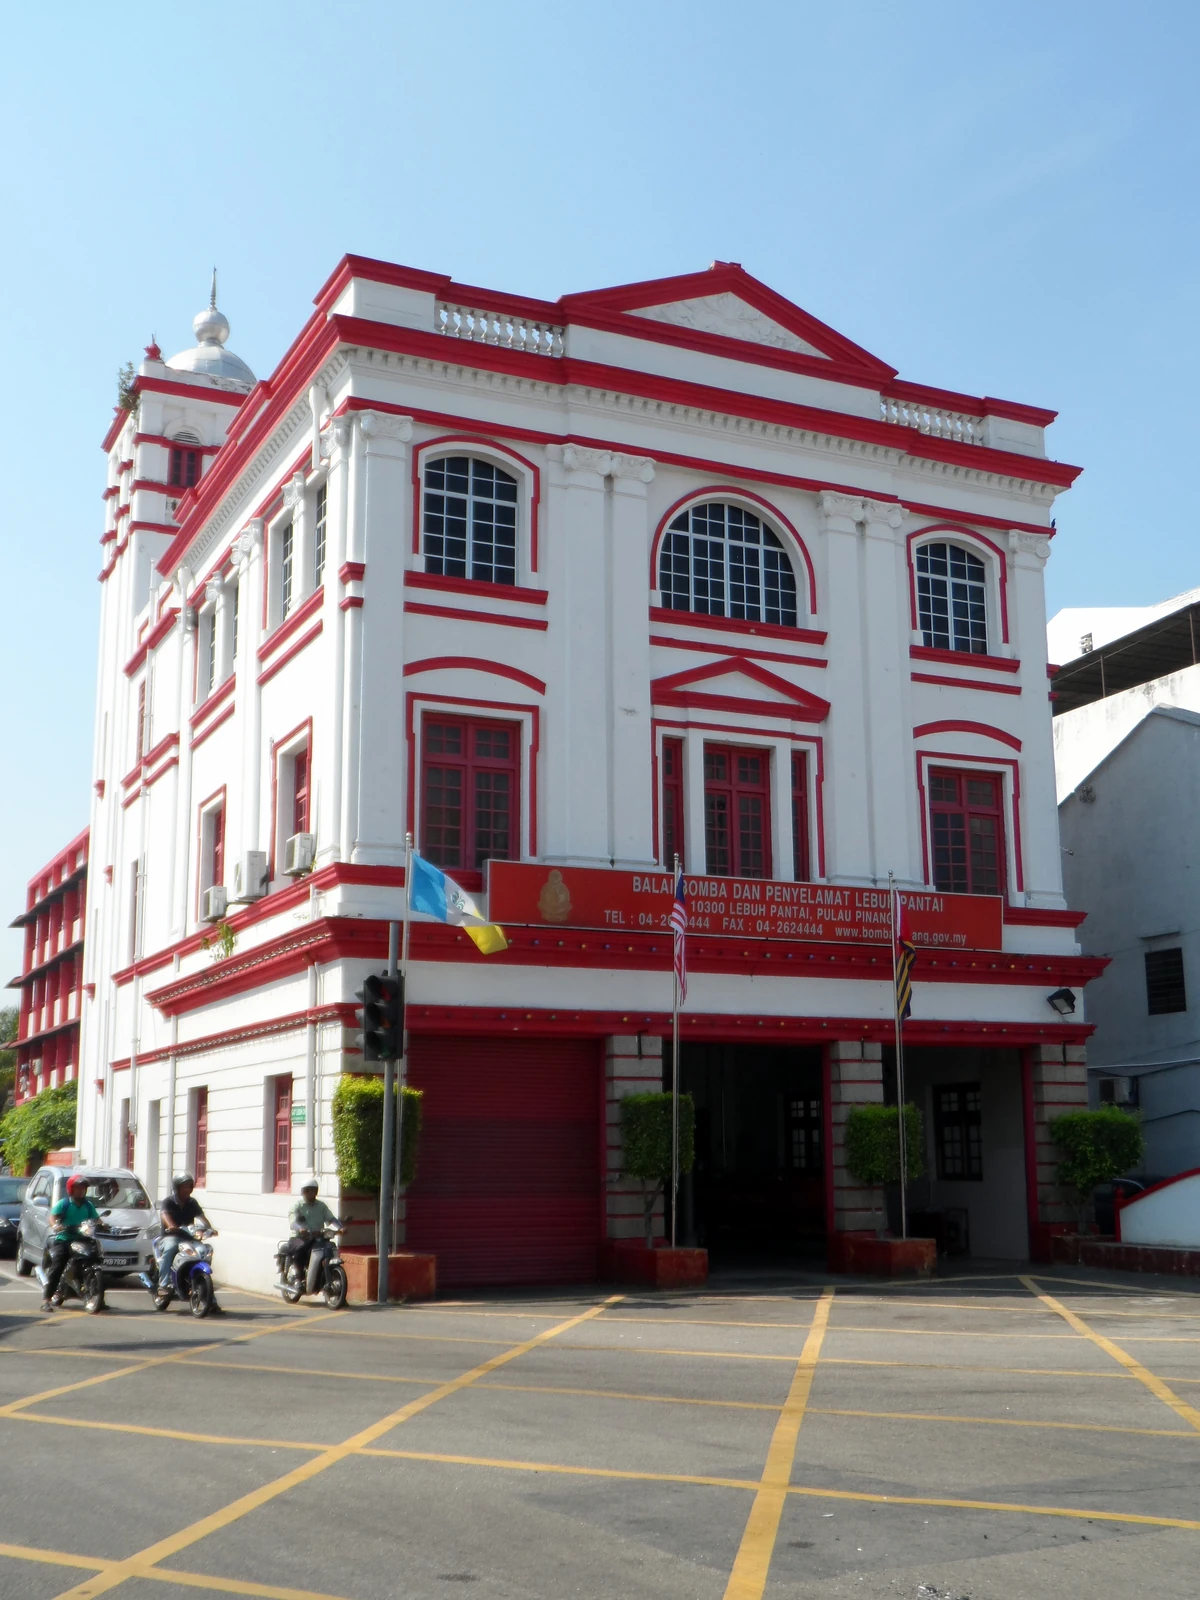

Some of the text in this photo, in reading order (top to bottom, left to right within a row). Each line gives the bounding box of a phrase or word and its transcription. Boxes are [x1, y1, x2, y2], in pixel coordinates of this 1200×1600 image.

[632, 876, 673, 894] BALAI
[733, 883, 760, 901] DAN
[765, 885, 851, 906] PENYELAMAT
[604, 909, 625, 924] TEL
[638, 912, 711, 929] 04-264444
[722, 916, 744, 931] FAX
[756, 919, 823, 936] 04-2624444
[690, 900, 725, 915] 10300
[730, 902, 766, 917] LEBUH
[770, 904, 812, 921] PANTAI,
[817, 907, 852, 923] PULAU
